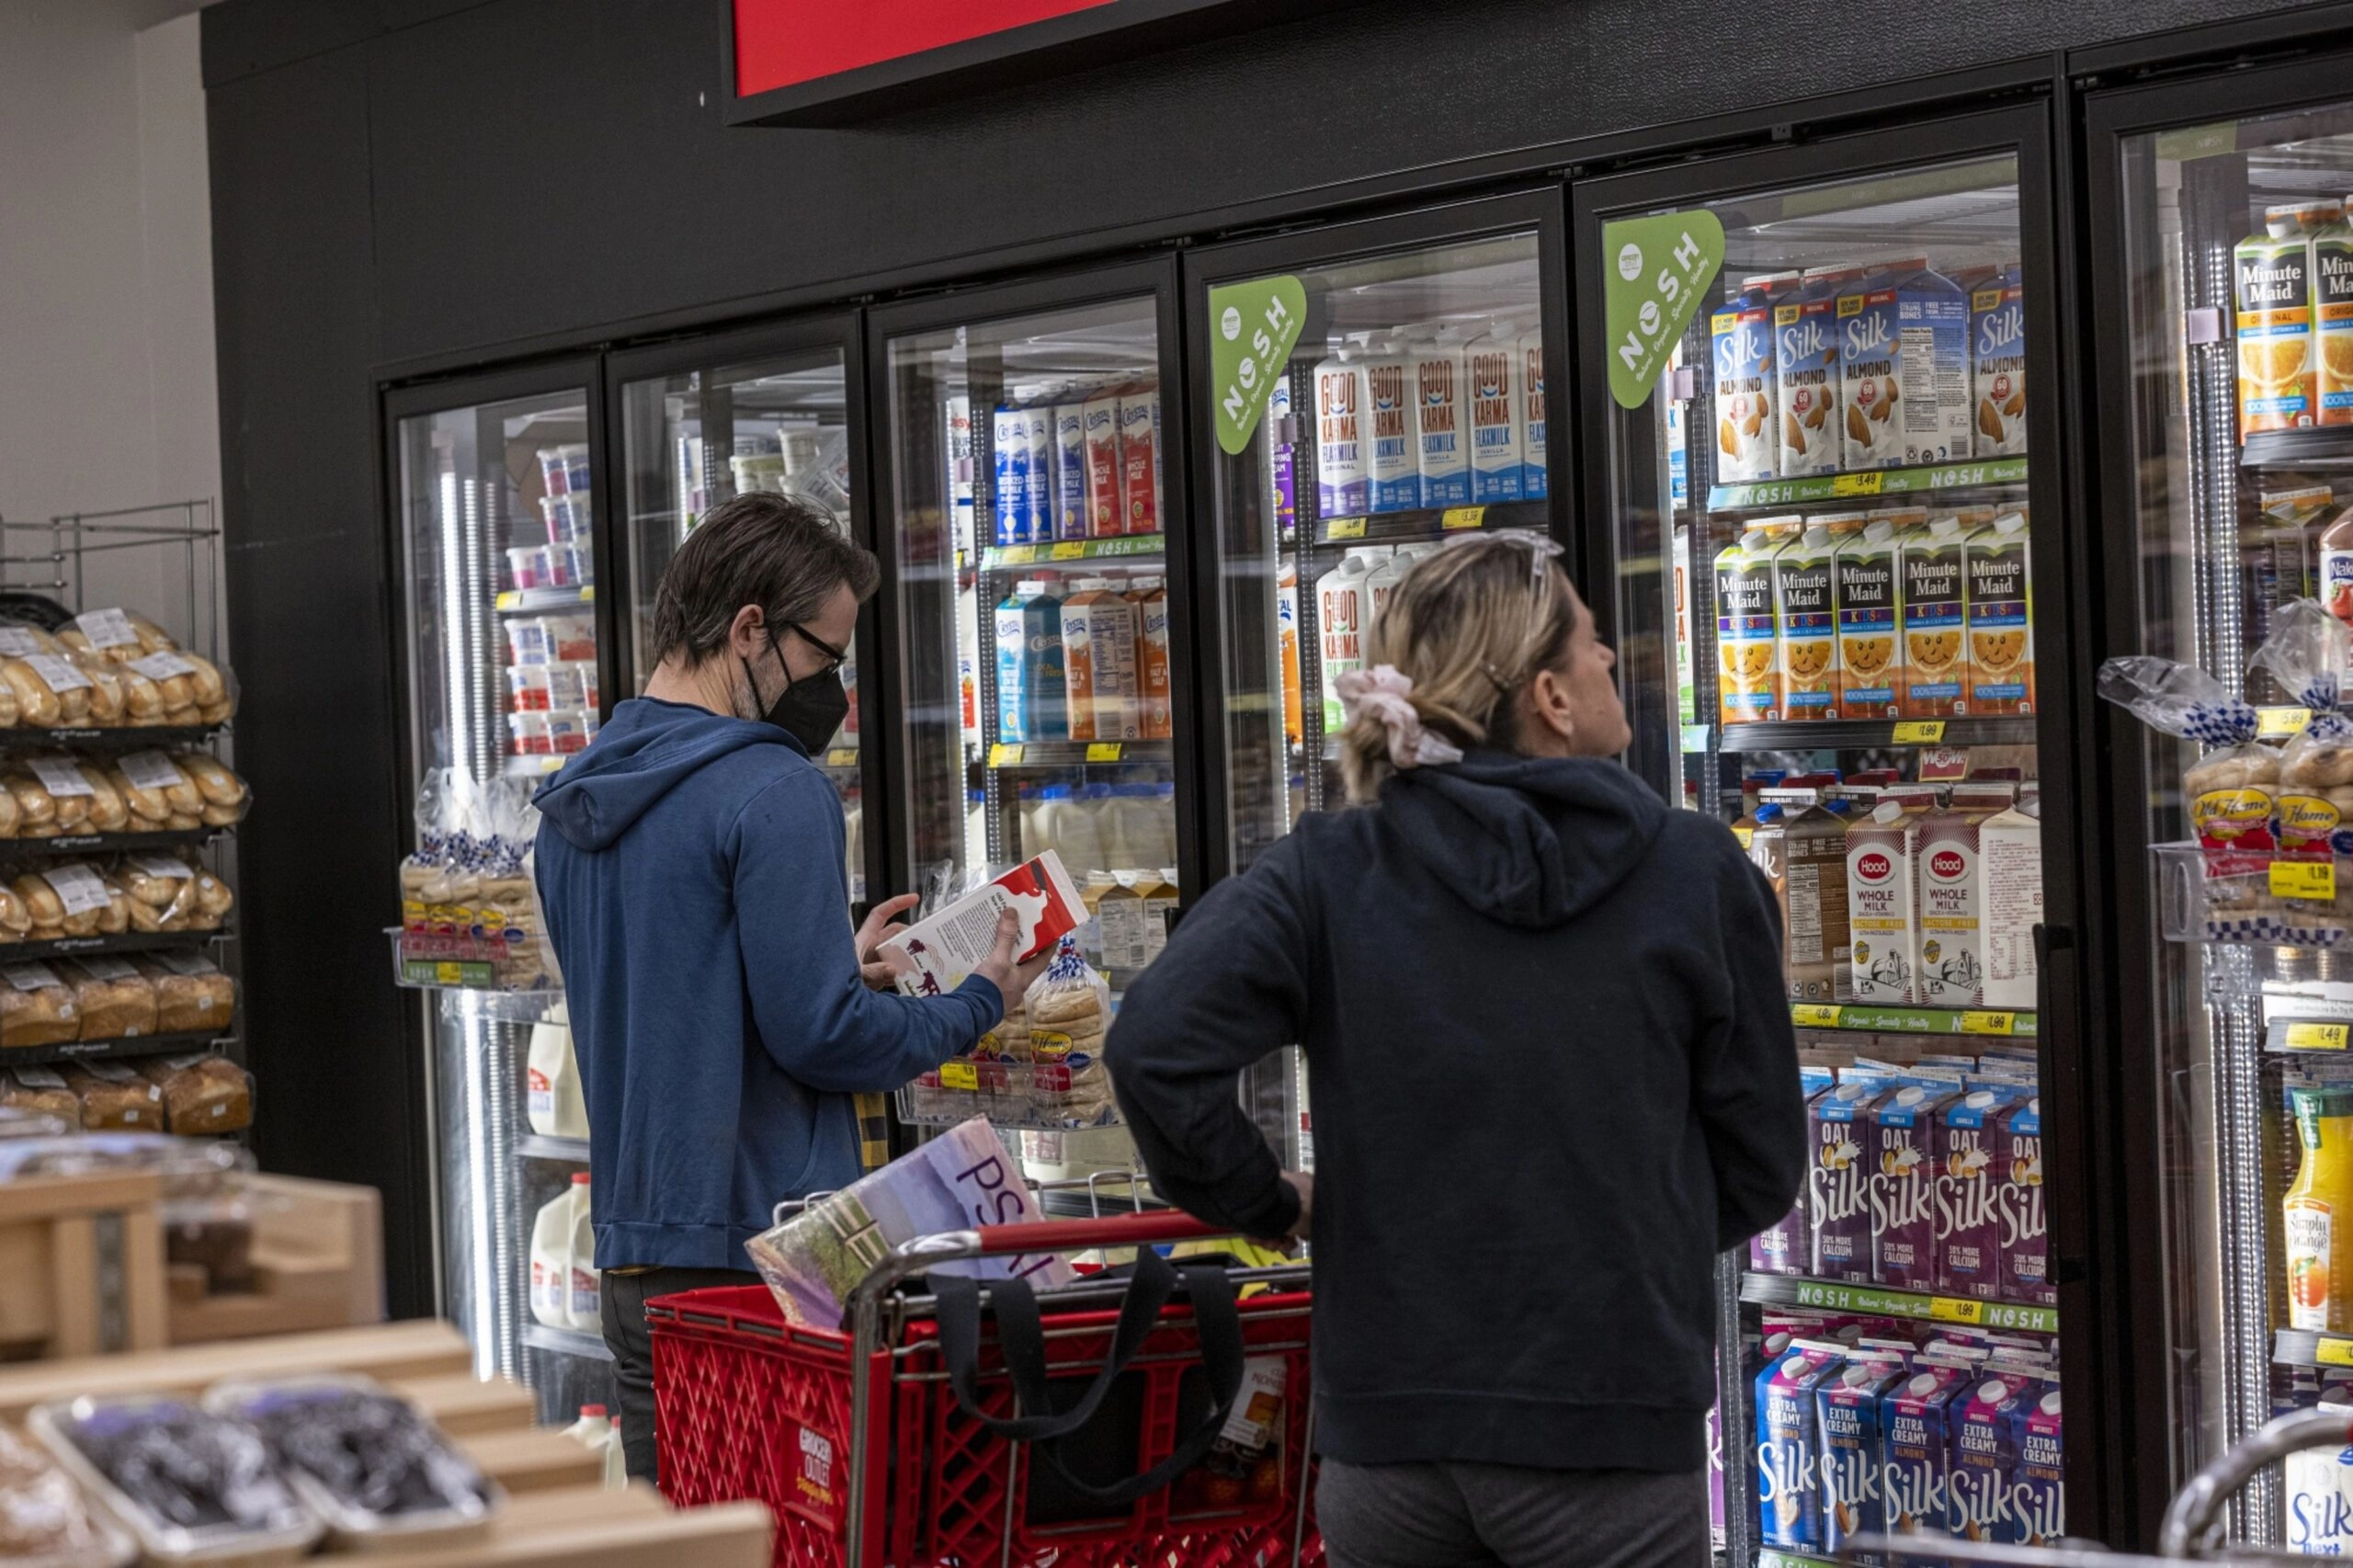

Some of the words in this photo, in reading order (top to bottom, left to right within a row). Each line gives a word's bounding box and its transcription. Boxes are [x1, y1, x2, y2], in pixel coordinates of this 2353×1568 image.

[2242, 264, 2302, 285] Minute
[2322, 256, 2353, 277] Min
[2250, 281, 2293, 302] Maid
[2328, 276, 2353, 294] Ma
[1619, 232, 1699, 371] NOSH
[2250, 312, 2292, 324] ORINAL
[2329, 308, 2353, 317] ORIG
[1781, 321, 1827, 369] Silk
[1845, 312, 1892, 360] Silk
[1222, 295, 1287, 421] NOSH
[1719, 329, 1763, 377] Silk
[1473, 352, 1508, 399] GOOD
[1528, 348, 1544, 393] GO
[1783, 370, 1826, 388] ALMOND
[1847, 360, 1891, 381] ALMOND
[1370, 366, 1403, 411] GOOD
[1419, 359, 1453, 405] GOOD
[1720, 377, 1762, 396] ALMOND
[1321, 372, 1356, 416] GOOD
[1123, 404, 1148, 426] CRYSTAL
[1474, 398, 1510, 426] KARMA
[1528, 395, 1545, 422] KAR
[1421, 405, 1455, 433] KARMA
[1322, 416, 1358, 444] KARMA
[1474, 426, 1510, 449] FLAXMILK
[1529, 423, 1545, 444] FLAX
[1422, 433, 1456, 454] FLAXMILK
[1930, 468, 1984, 488] NOSH
[1744, 486, 1792, 505] NOSH
[1097, 541, 1131, 556] NOSH
[1842, 568, 1888, 585] Minute
[1909, 562, 1957, 579] Minute
[1972, 560, 2020, 577] Minute
[2331, 562, 2353, 577] Nak
[1721, 576, 1768, 593] Minute
[1781, 574, 1827, 589] Minute
[1915, 577, 1950, 596] Maid
[1978, 577, 2014, 596] Maid
[1726, 592, 1761, 608] Maid
[1787, 589, 1820, 607] Maid
[1848, 584, 1881, 601] Maid
[1324, 590, 1357, 632] GOOD
[1063, 618, 1086, 636] CRYSTAL
[1324, 634, 1359, 660] KARMA
[2222, 797, 2268, 817] Home
[2288, 803, 2335, 824] Home
[1861, 861, 1887, 872] Hood
[1935, 858, 1961, 871] Hood
[1858, 891, 1894, 901] WHOLE
[1929, 889, 1967, 900] WHOLE
[1864, 902, 1887, 911] MILK
[1936, 901, 1960, 910] MILK
[1822, 1122, 1850, 1144] OAT
[1882, 1129, 1912, 1150] OAT
[1949, 1130, 1980, 1151] OAT
[1809, 1161, 1869, 1230] Silk
[1870, 1167, 1931, 1237] Silk
[1936, 1169, 1998, 1241] Silk
[1999, 1183, 2047, 1249] Sil
[2290, 1213, 2327, 1237] Simply
[1823, 1244, 1852, 1257] CALCIUM
[1884, 1251, 1915, 1266] CALCIUM
[1962, 1246, 1980, 1257] MORE
[1949, 1256, 1980, 1268] CALCIUM
[1799, 1288, 1849, 1307] NOSH
[1990, 1308, 2044, 1329] NOSH
[1768, 1397, 1797, 1413] EXTRA
[1829, 1408, 1858, 1423] EXTRA
[1894, 1416, 1924, 1432] EXTRA
[1826, 1420, 1860, 1436] CREAMY
[1892, 1429, 1927, 1446] CREAMY
[1963, 1424, 1994, 1439] EXTRA
[1894, 1446, 1926, 1460] ALMOND
[1960, 1436, 1997, 1453] CREAMY
[2027, 1436, 2057, 1452] EXTRA
[1963, 1453, 1995, 1468] ALMOND
[2023, 1449, 2062, 1466] CREAMY
[1758, 1440, 1815, 1503] Silk
[1821, 1449, 1880, 1514] Silk
[1884, 1460, 1945, 1525] Silk
[1950, 1468, 2013, 1534] Silk
[2290, 1491, 2353, 1545] Silk
[2302, 1542, 2341, 1556] next
